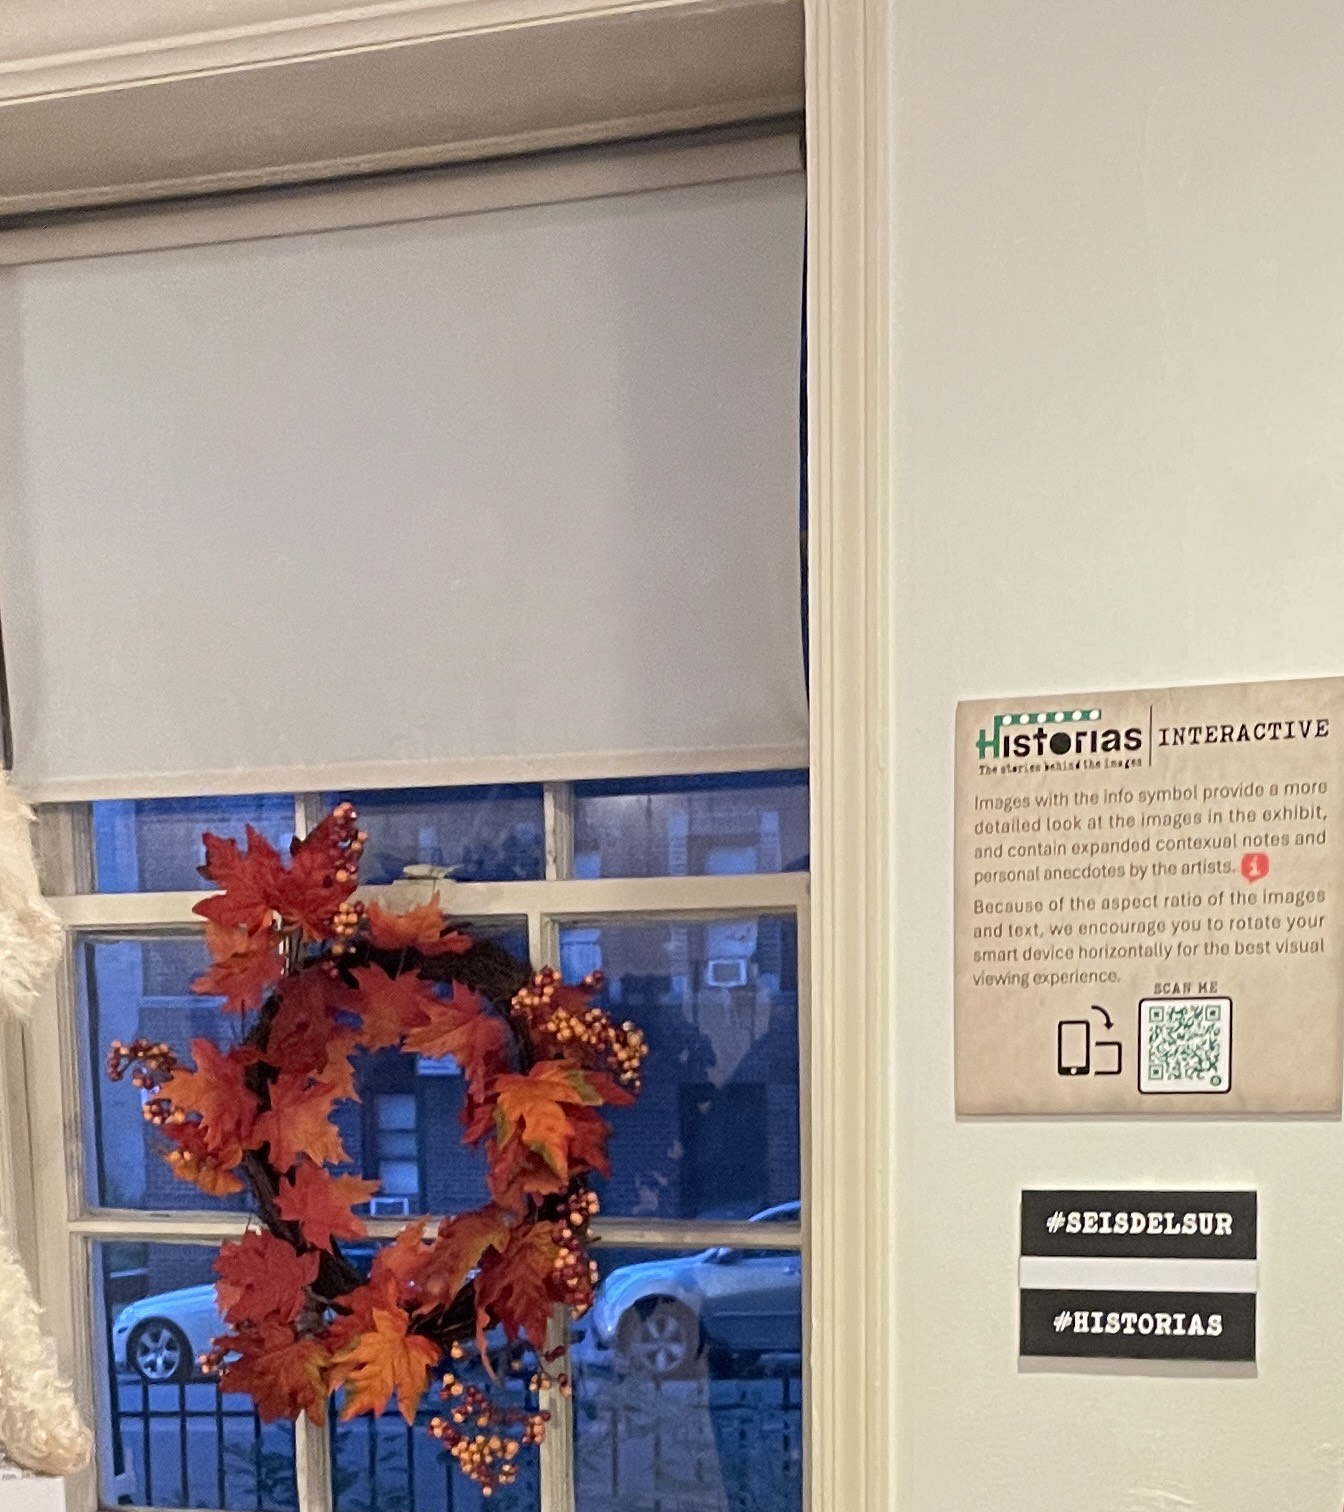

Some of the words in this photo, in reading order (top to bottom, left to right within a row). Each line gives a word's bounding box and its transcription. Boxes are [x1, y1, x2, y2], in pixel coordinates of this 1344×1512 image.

[976, 709, 1142, 759] Historias
[1159, 718, 1330, 747] INTERACTIVE
[979, 765, 997, 775] The
[974, 795, 1030, 814] Images
[1035, 792, 1068, 808] with
[1073, 791, 1098, 806] the
[1104, 789, 1134, 805] info
[1138, 784, 1198, 806] symbol
[1203, 782, 1264, 805] provide
[1269, 784, 1278, 796] a
[1284, 781, 1327, 796] more
[974, 819, 1041, 836] detailed
[1047, 816, 1081, 832] look
[1088, 817, 1103, 830] at
[1109, 814, 1136, 829] the
[1141, 811, 1202, 830] images
[1208, 809, 1223, 825] in
[1229, 809, 1256, 824] the
[1262, 805, 1328, 824] exhibit,
[974, 843, 1003, 860] and
[1007, 841, 1066, 858] contain
[1071, 837, 1151, 861] expanded
[1242, 833, 1290, 848] notes
[1295, 829, 1326, 846] and
[973, 865, 1039, 886] personal
[1043, 862, 1125, 880] anecdotes
[1130, 861, 1148, 879] by
[1152, 861, 1177, 876] the
[1181, 860, 1236, 876] artists.
[973, 898, 1043, 915] Because
[1049, 897, 1064, 912] of
[1070, 896, 1096, 911] the
[1101, 894, 1158, 913] aspect
[1164, 892, 1202, 908] ratio
[1208, 891, 1225, 906] of
[1230, 890, 1256, 905] the
[1263, 888, 1326, 908] images
[973, 923, 1003, 938] and
[1008, 922, 1044, 941] text,
[1049, 922, 1073, 936] we
[1079, 919, 1166, 938] encourage
[1171, 919, 1201, 936] you
[1207, 917, 1223, 932] to
[1229, 916, 1281, 930] rotate
[1287, 914, 1326, 932] your
[973, 947, 1018, 963] smart
[1023, 945, 1074, 961] device
[1079, 940, 1173, 961] horizontally
[1177, 940, 1198, 956] for
[1204, 940, 1230, 955] the
[1234, 938, 1271, 955] best
[1276, 938, 1325, 954] visual
[973, 971, 1030, 989] viewing
[1033, 969, 1122, 987] experience.
[1046, 1210, 1233, 1236] #SEISDELSUR
[1053, 1310, 1223, 1337] #HISTORIAS
